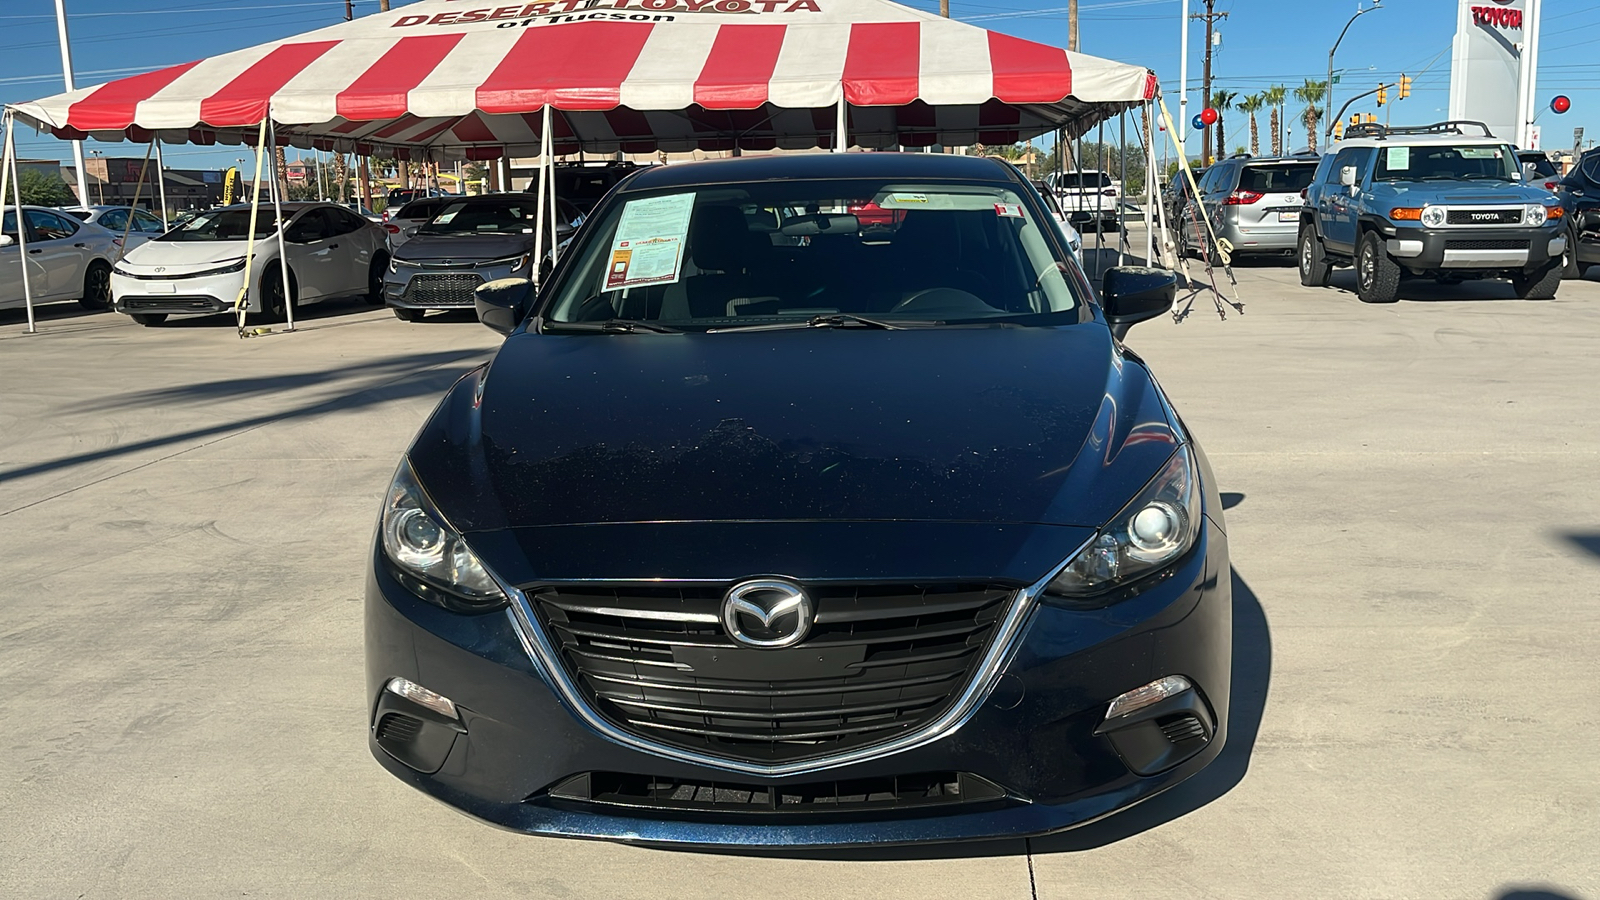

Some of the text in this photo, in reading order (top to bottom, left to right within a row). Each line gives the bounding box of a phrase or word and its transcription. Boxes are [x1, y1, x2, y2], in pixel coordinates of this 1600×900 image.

[390, 0, 587, 27] DESERT
[497, 12, 676, 28] of Tucson
[1471, 6, 1522, 30] TOYOTA
